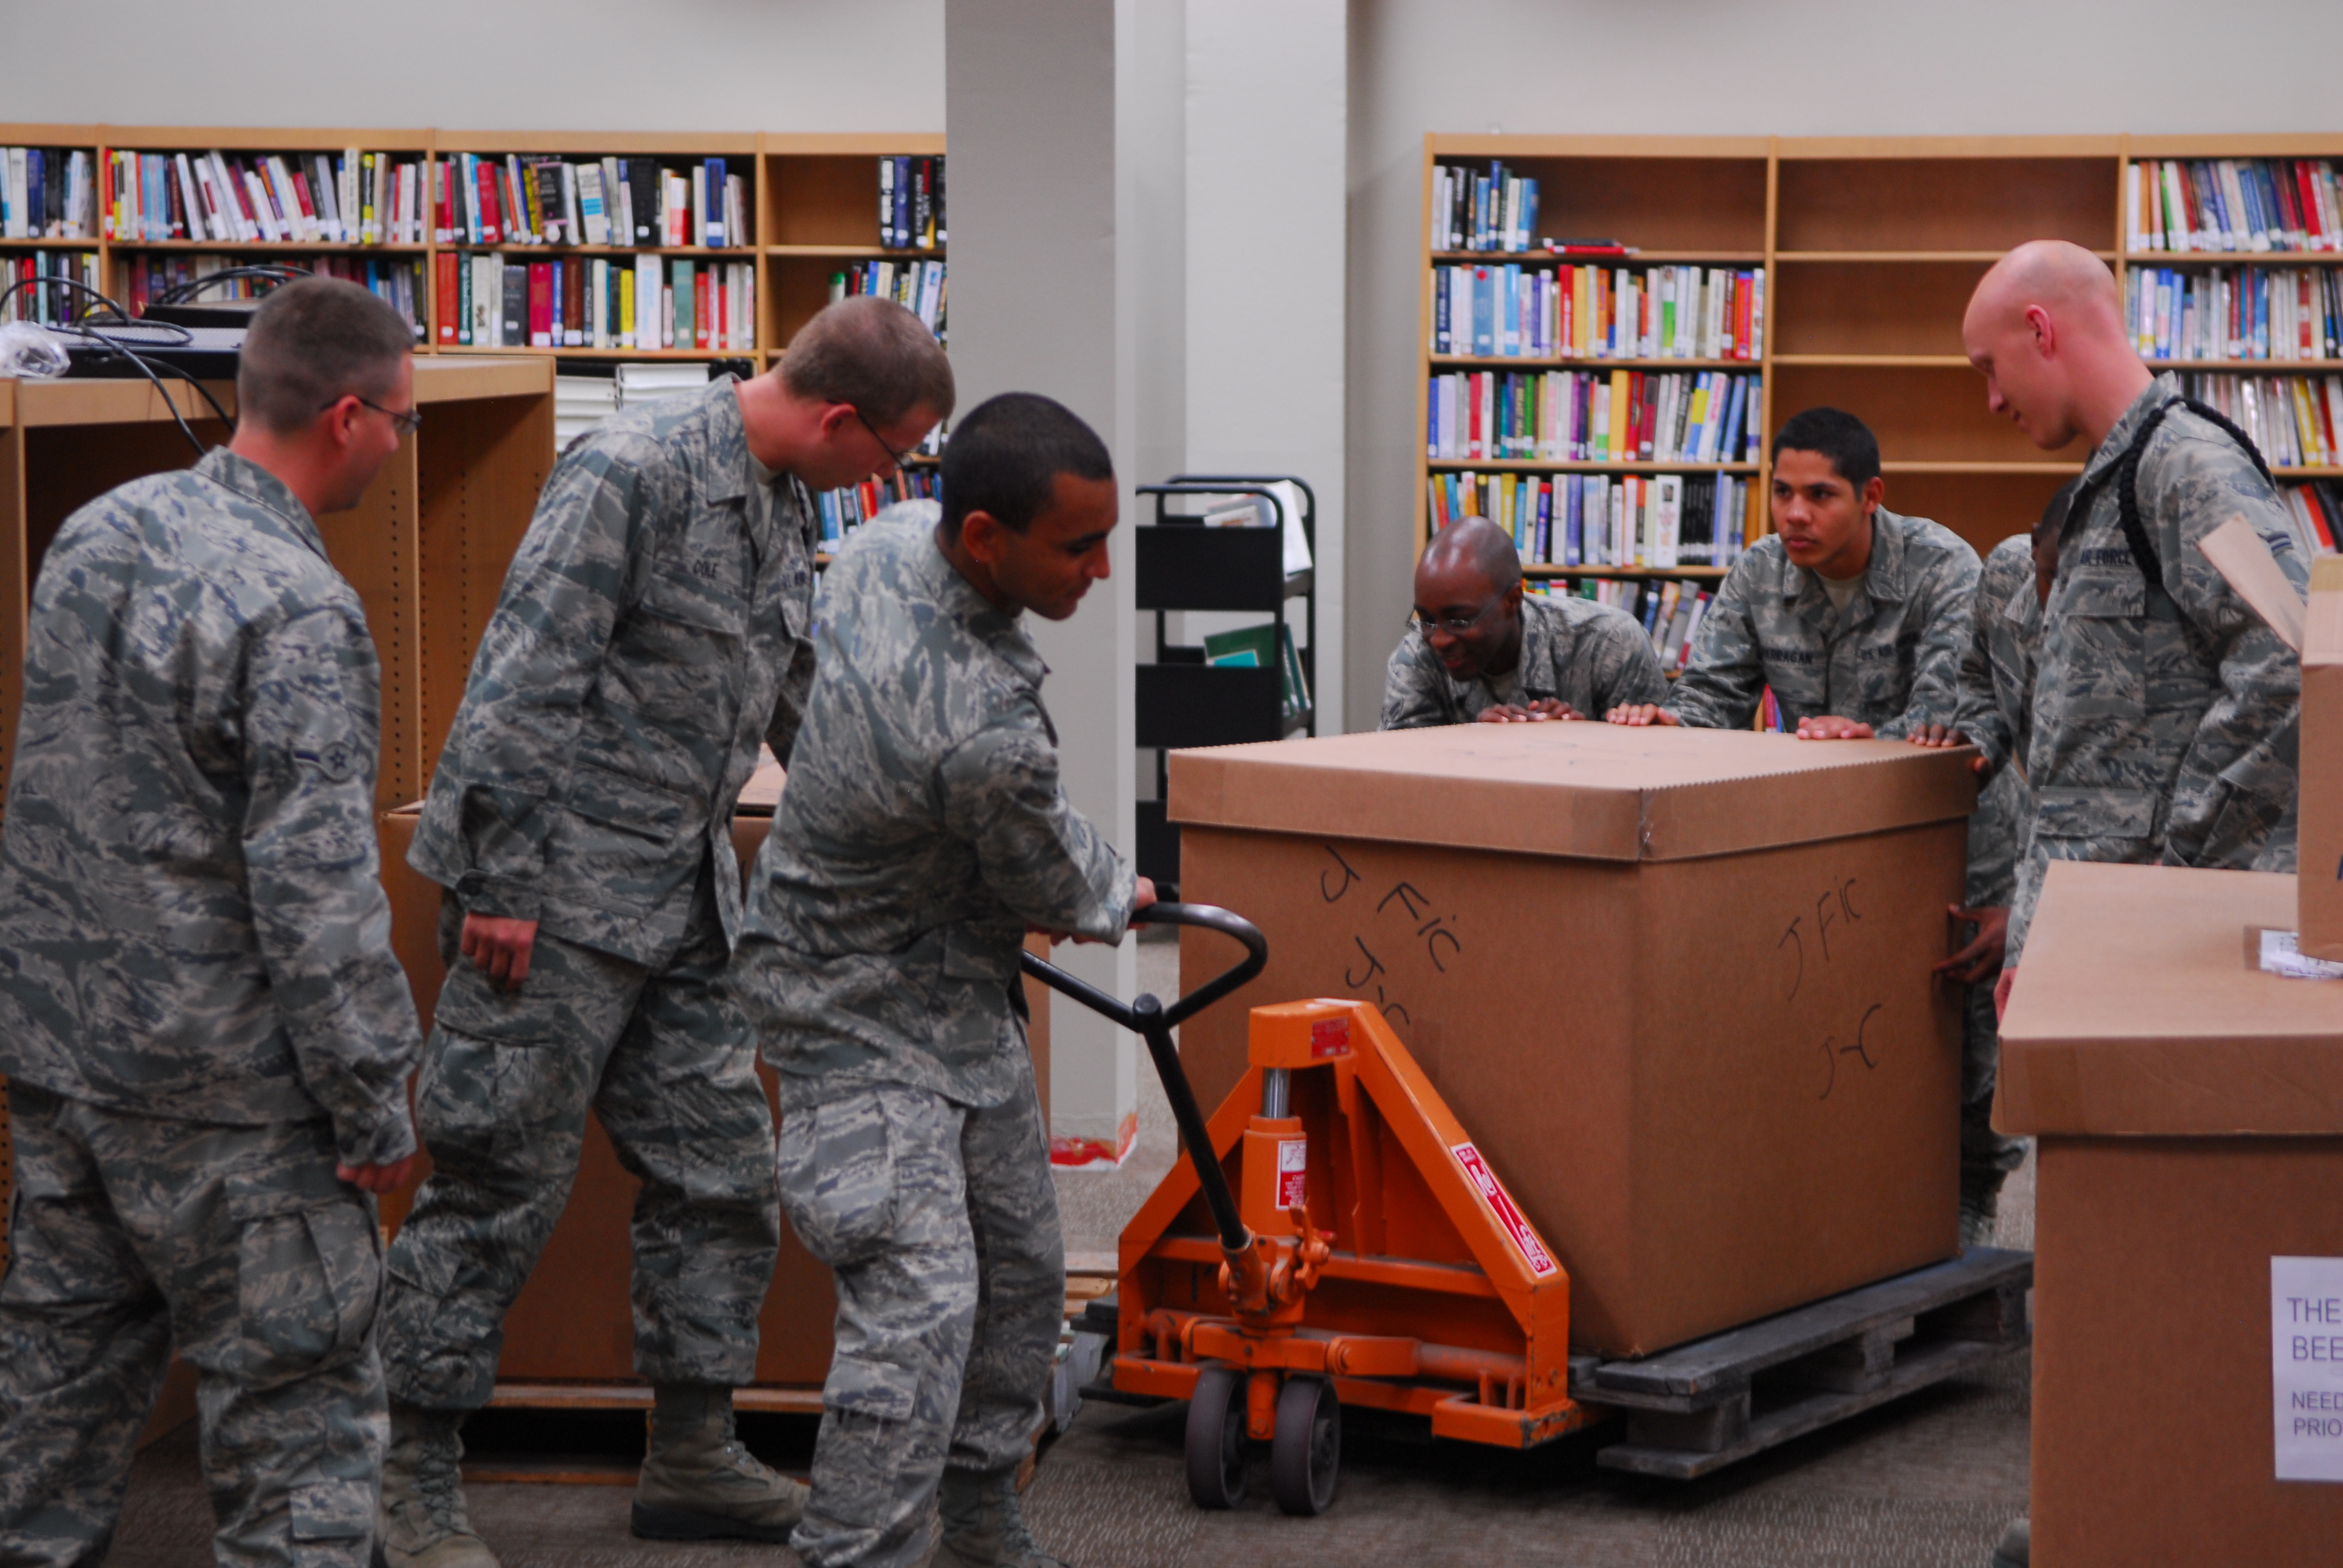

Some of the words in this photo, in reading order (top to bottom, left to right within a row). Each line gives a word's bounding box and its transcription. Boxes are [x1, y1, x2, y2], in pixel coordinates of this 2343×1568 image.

[693, 559, 718, 579] COLE
[2287, 1297, 2342, 1323] THE
[2293, 1417, 2343, 1437] PRIO
